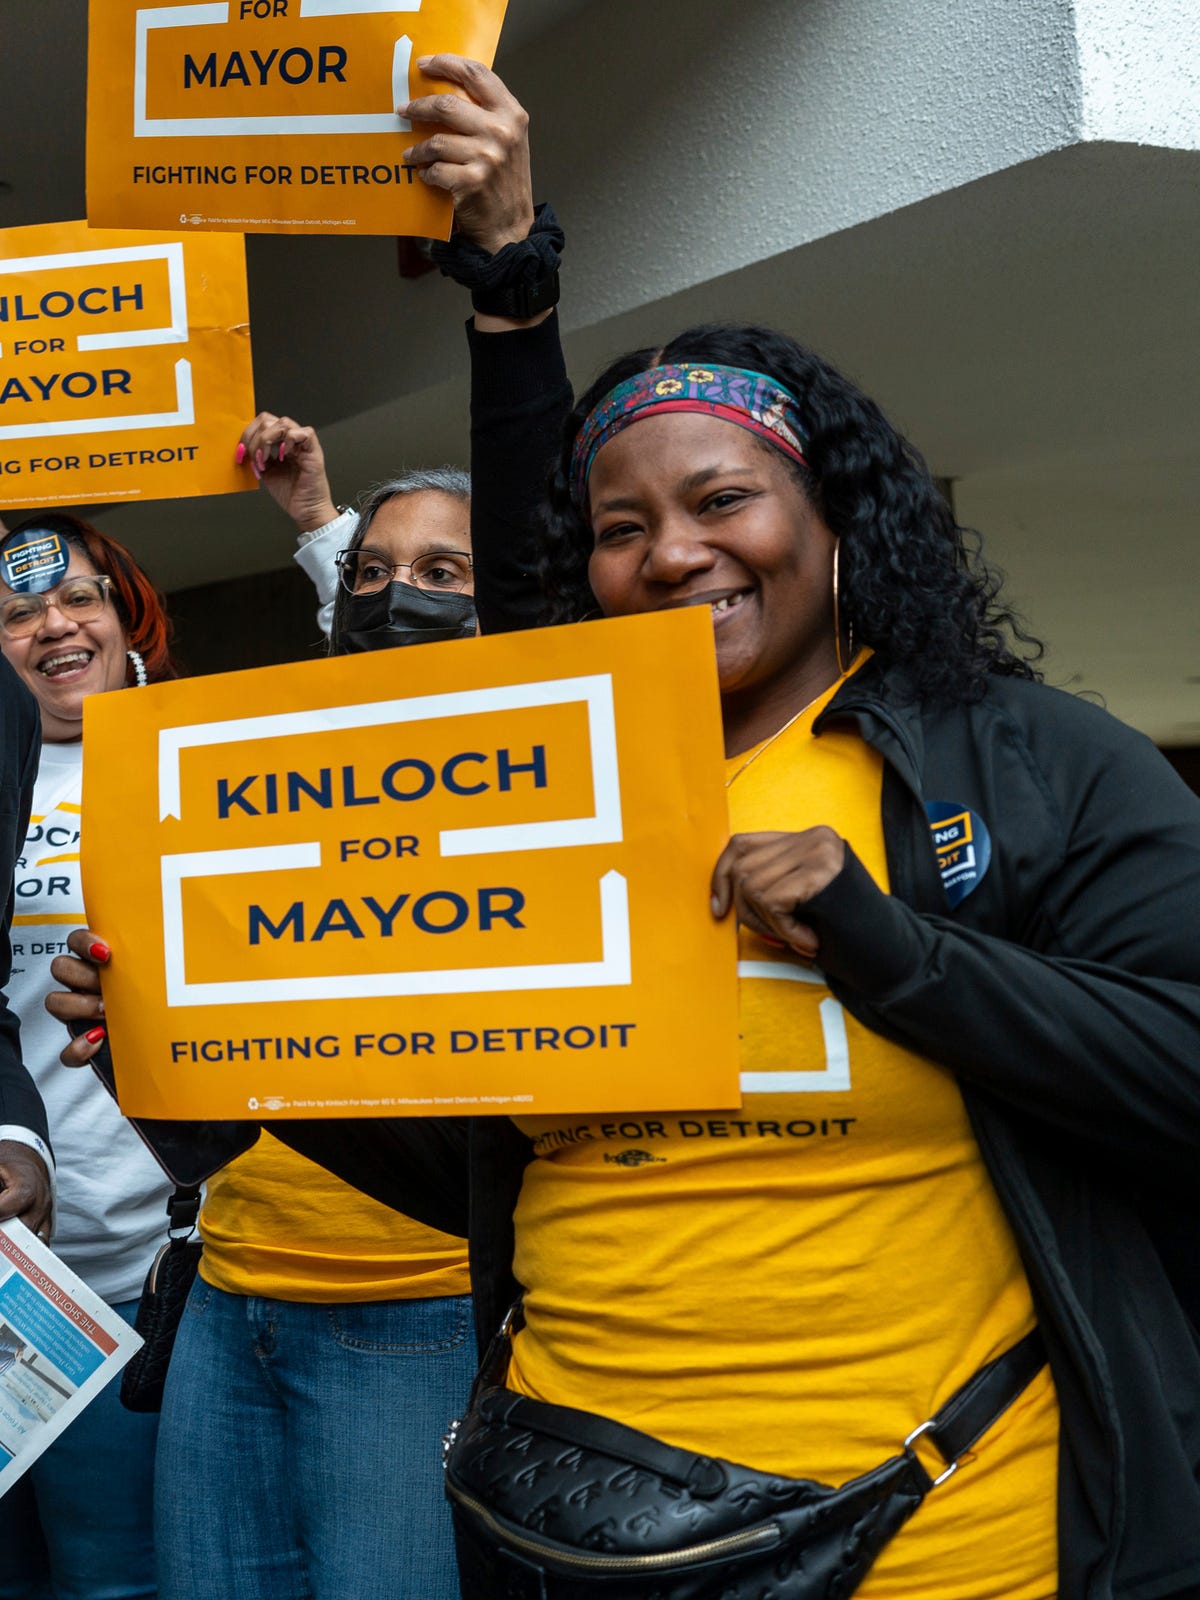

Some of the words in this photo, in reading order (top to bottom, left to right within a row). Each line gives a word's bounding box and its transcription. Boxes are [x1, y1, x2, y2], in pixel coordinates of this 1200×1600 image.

[239, 0, 288, 20] FOR
[183, 45, 348, 89] MAYOR
[133, 165, 237, 185] FIGHTING
[245, 165, 293, 185] FOR
[300, 164, 417, 185] DETROIT
[14, 337, 65, 356] FOR
[29, 455, 80, 473] FOR
[88, 446, 199, 469] DETROIT
[12, 542, 53, 560] FIGHTING
[15, 556, 55, 573] DETROIT
[217, 745, 547, 819] KINLOCH
[340, 835, 419, 863] FOR
[248, 886, 525, 945] MAYOR
[170, 1035, 340, 1063] FIGHTING
[354, 1032, 435, 1057] FOR
[450, 1023, 636, 1054] DETROIT
[601, 1121, 669, 1140] FOR
[678, 1118, 857, 1138] DETROIT
[9, 1246, 42, 1279] captures
[36, 1275, 62, 1301] NEWS
[58, 1296, 83, 1320] SHOT
[78, 1315, 97, 1334] THE
[1, 1410, 18, 1427] Force
[15, 1424, 26, 1435] Air
